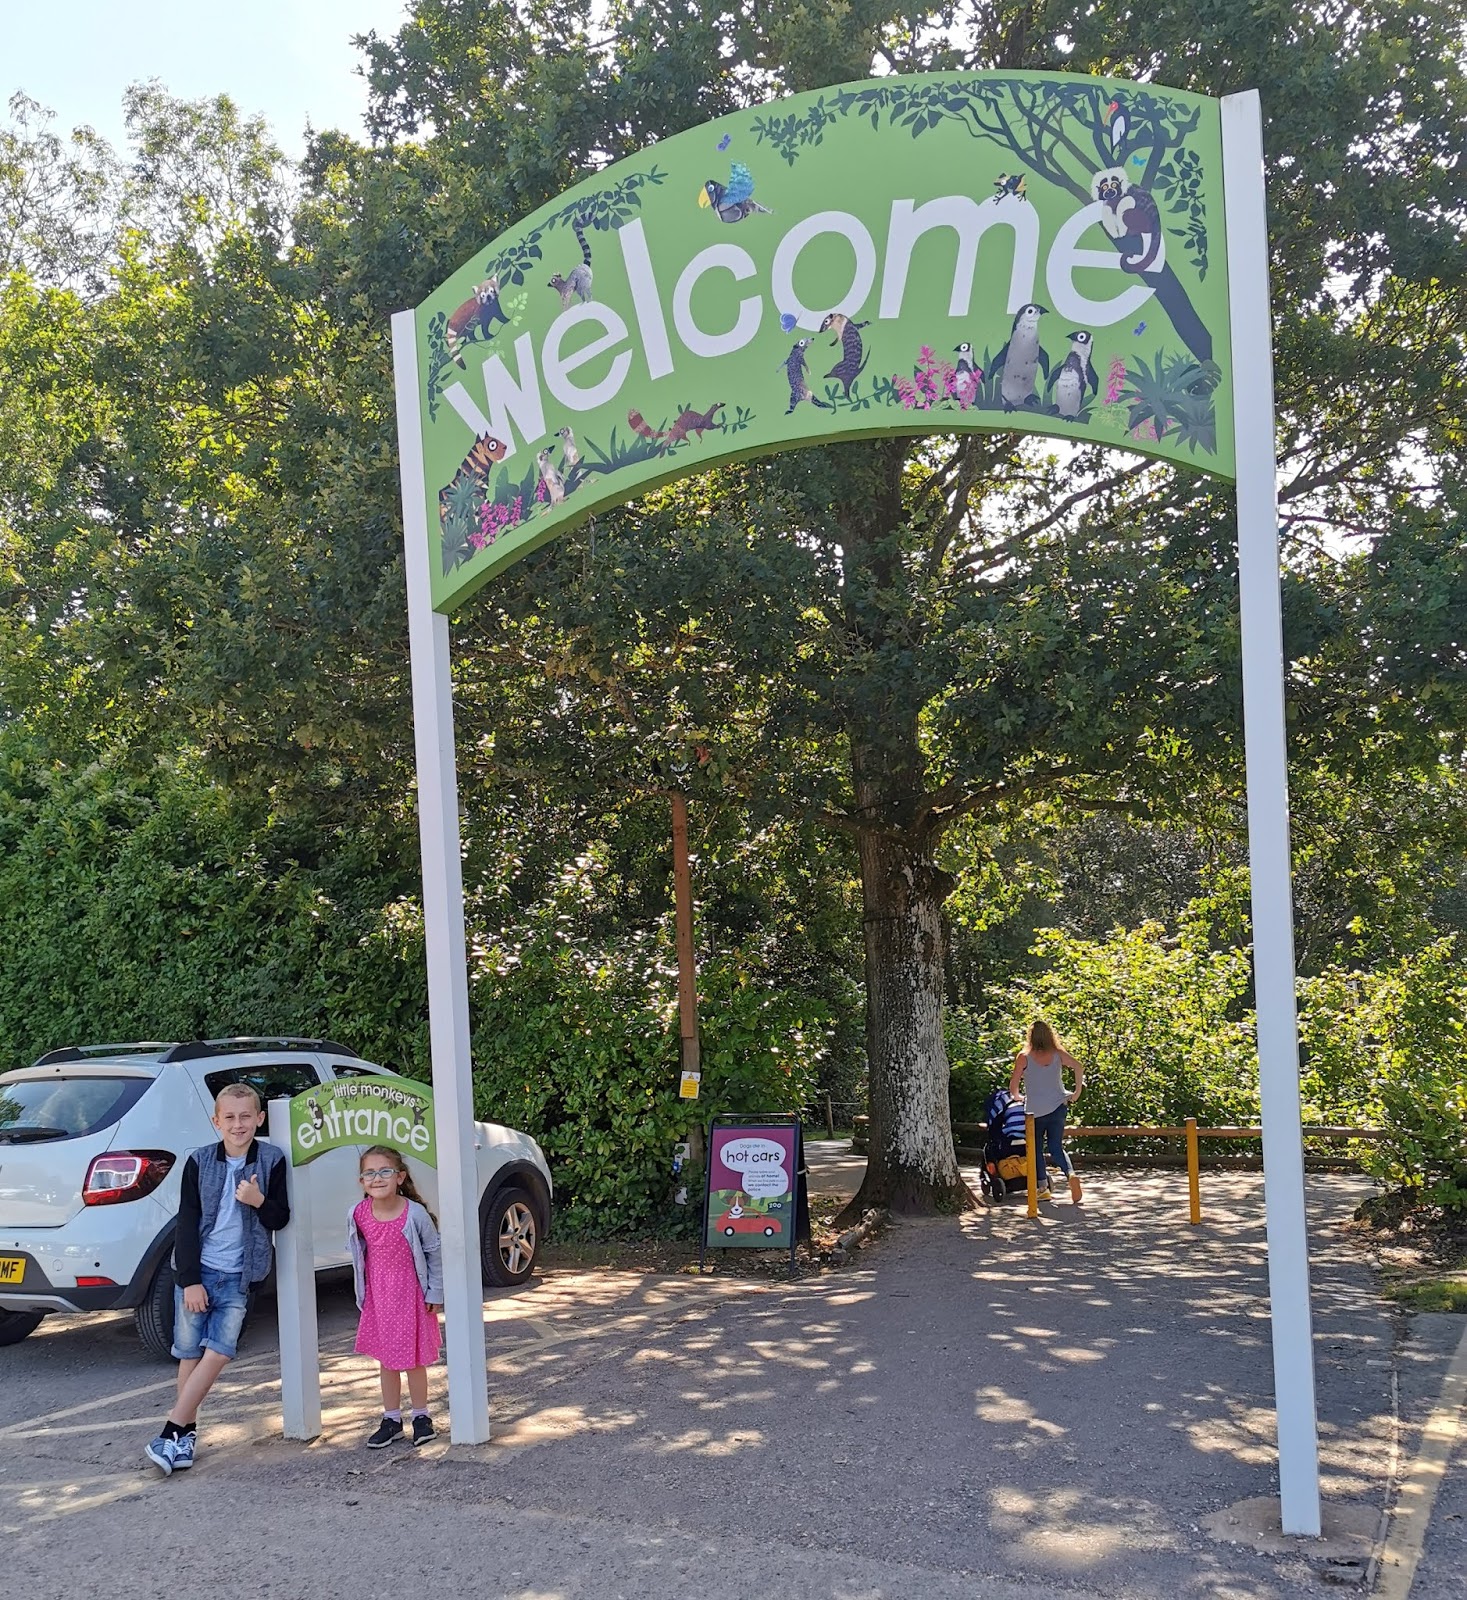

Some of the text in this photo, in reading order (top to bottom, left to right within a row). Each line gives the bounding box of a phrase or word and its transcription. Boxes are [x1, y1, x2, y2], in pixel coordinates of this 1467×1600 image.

[442, 195, 1166, 464] welcome
[333, 1083, 358, 1098] little
[297, 1100, 430, 1152] entrance
[726, 1150, 780, 1163] hot cars
[0, 1261, 19, 1279] MF
